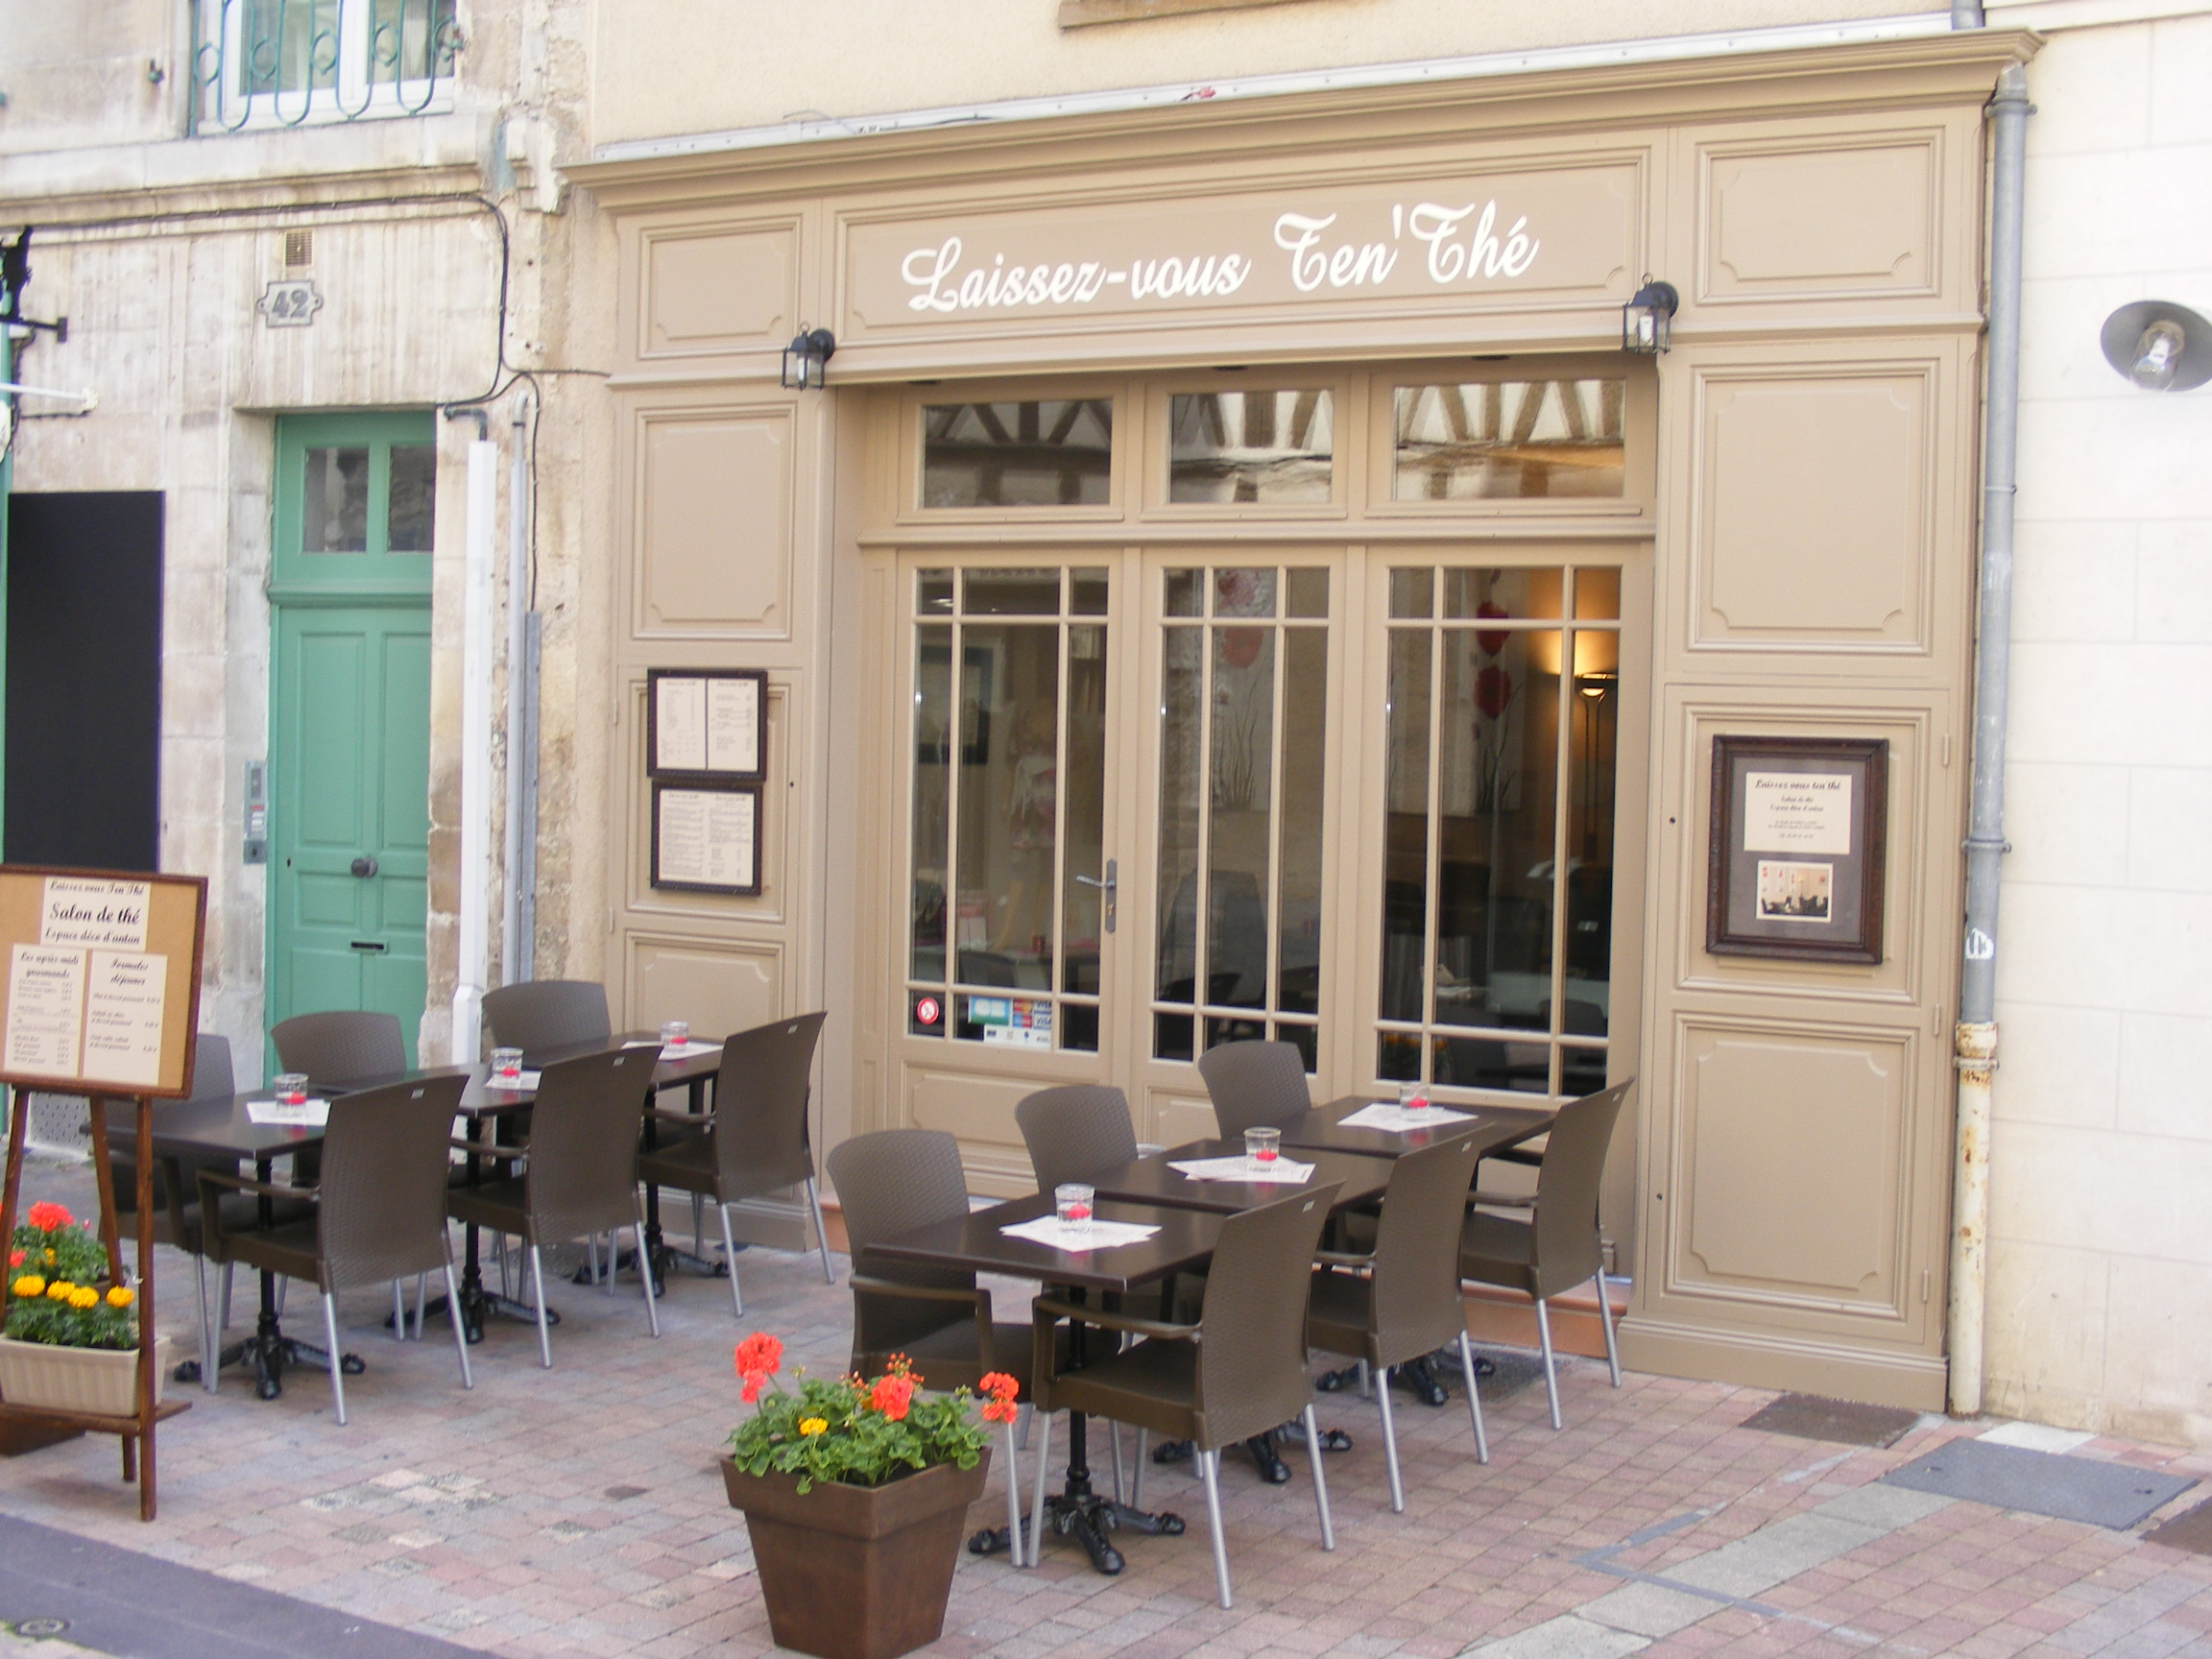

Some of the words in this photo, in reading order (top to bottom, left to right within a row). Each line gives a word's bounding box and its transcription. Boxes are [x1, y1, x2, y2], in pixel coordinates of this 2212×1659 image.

[901, 235, 1251, 312] Laissez-vous
[272, 289, 309, 319] 42
[50, 902, 93, 923] Salon
[96, 904, 114, 924] de
[117, 905, 141, 926] thé
[45, 926, 78, 943] Espace
